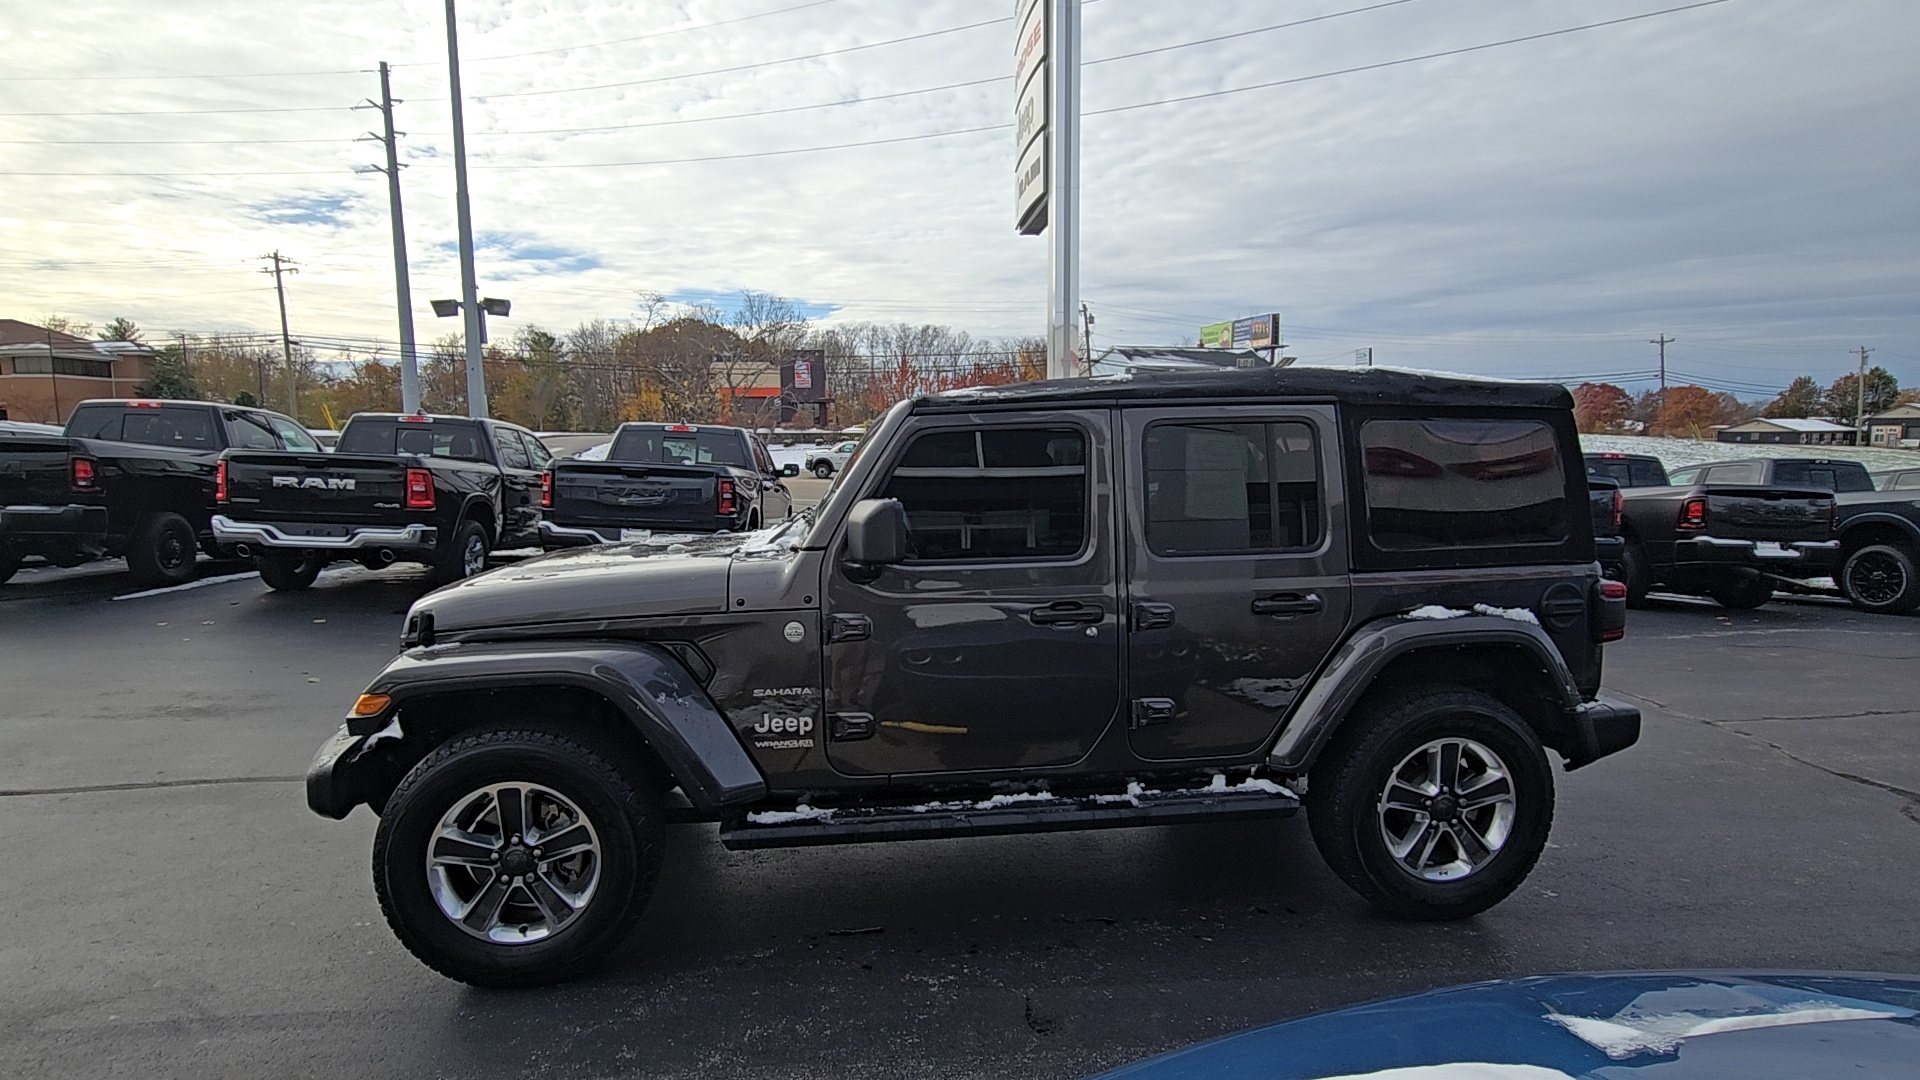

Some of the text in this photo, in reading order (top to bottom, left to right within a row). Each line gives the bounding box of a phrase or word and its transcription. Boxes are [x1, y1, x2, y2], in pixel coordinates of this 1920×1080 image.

[272, 476, 356, 490] RAM
[753, 687, 812, 697] SAHARA
[754, 713, 814, 736] Jeep
[754, 739, 814, 750] WRANGLER
